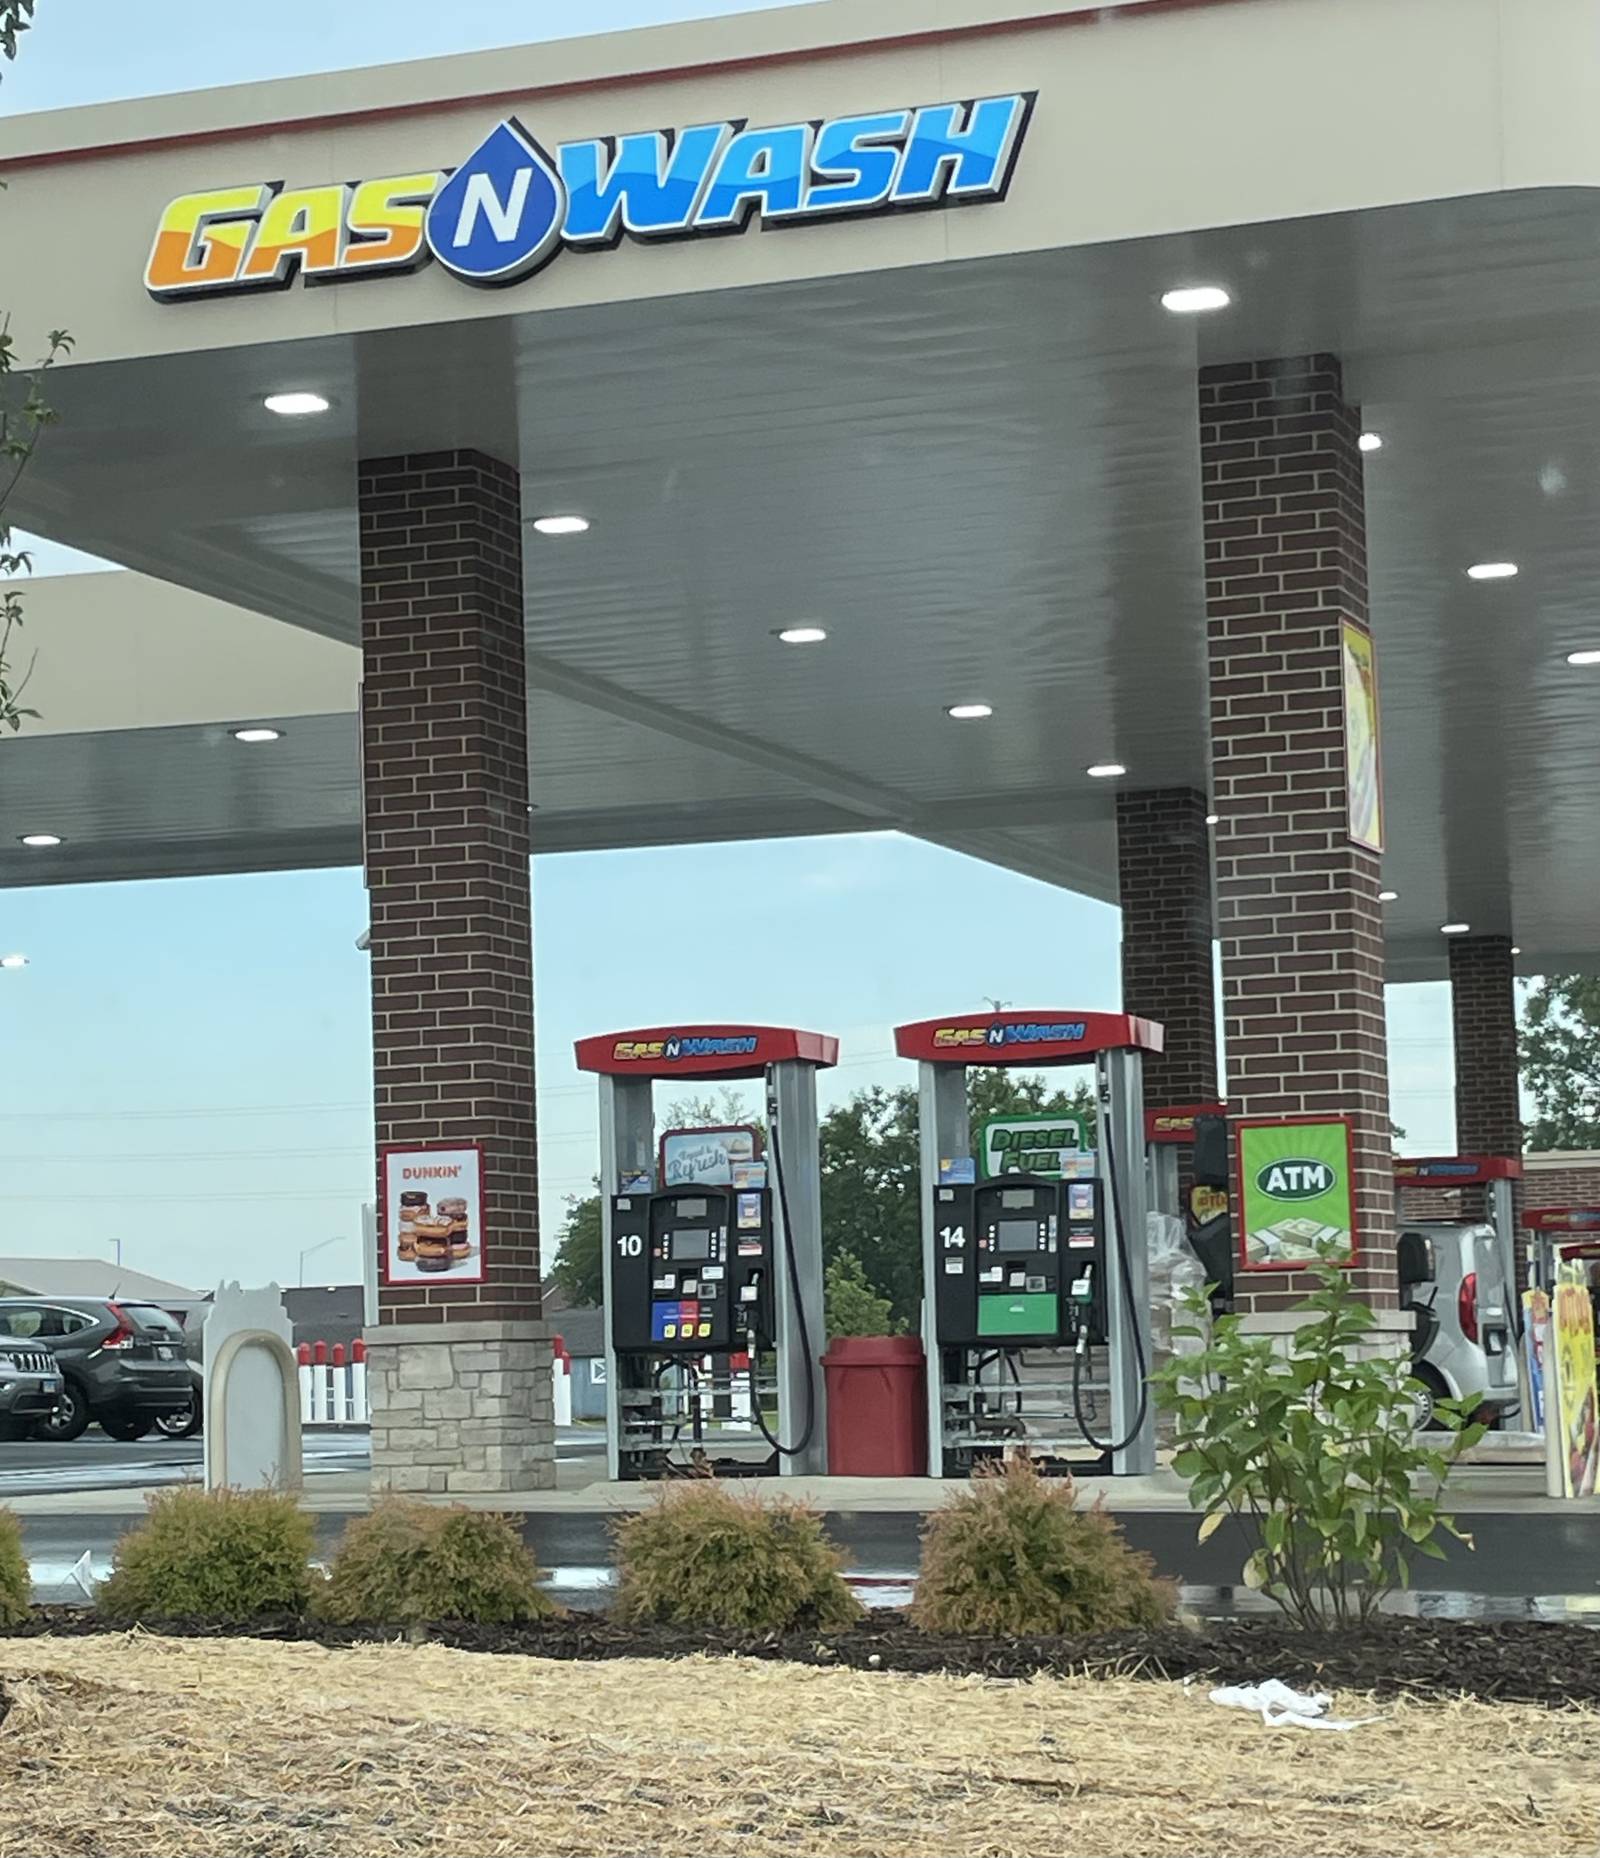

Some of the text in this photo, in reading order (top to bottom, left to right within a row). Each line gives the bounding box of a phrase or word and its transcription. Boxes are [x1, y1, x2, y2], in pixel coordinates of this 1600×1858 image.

[143, 94, 1026, 291] GAS N WASH
[933, 1023, 1086, 1047] GAS N WASH
[613, 1036, 757, 1060] GAS N WASH
[991, 1128, 1079, 1150] DIESEL
[402, 1165, 462, 1180] DUNKIN'
[1002, 1150, 1062, 1173] FUEL
[1265, 1165, 1326, 1192] ATM
[617, 1235, 642, 1257] 10
[939, 1226, 966, 1249] 14
